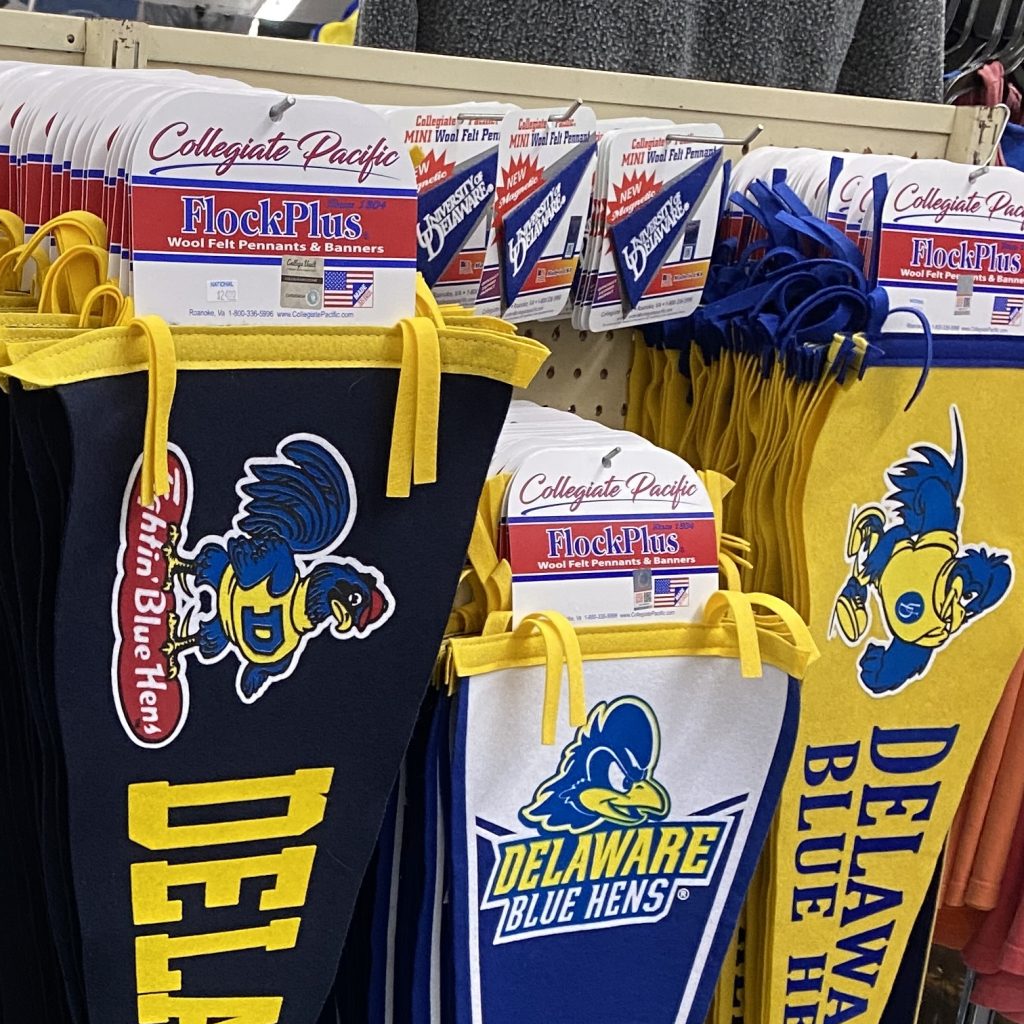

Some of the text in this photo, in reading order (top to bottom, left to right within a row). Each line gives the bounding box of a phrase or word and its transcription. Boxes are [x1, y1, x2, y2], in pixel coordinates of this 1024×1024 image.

[404, 129, 433, 143] MINI
[435, 128, 459, 143] Wool
[461, 128, 480, 142] Felt
[416, 114, 456, 128] Collegiate
[149, 121, 399, 184] Collegiate Pacific
[509, 130, 590, 148] MINI Wool Felt Pennant
[631, 137, 667, 150] Collegiate
[621, 146, 716, 167] MINI Wool Felt Pennant
[498, 176, 538, 209] Magnetic
[507, 166, 527, 190] NEW
[620, 181, 642, 204] NEW
[180, 194, 363, 241] FlockPlus
[611, 190, 656, 222] Magnetic
[894, 182, 981, 223] Collegiate
[167, 236, 385, 254] Wool Felt Pennants & Banners
[910, 237, 1022, 274] FlockPlus
[900, 268, 924, 278] Wool
[926, 270, 943, 279] Felt
[988, 274, 996, 283] &
[520, 471, 698, 512] Collegiate Pacific
[546, 525, 679, 558] FlockPlus
[537, 556, 696, 570] Wool Felt Pennants & Banners
[134, 588, 167, 660] Blue
[134, 663, 167, 735] Hens
[791, 740, 861, 923] BLUE
[493, 826, 722, 896] DELAWARE
[504, 877, 670, 932] BLUE HENS
